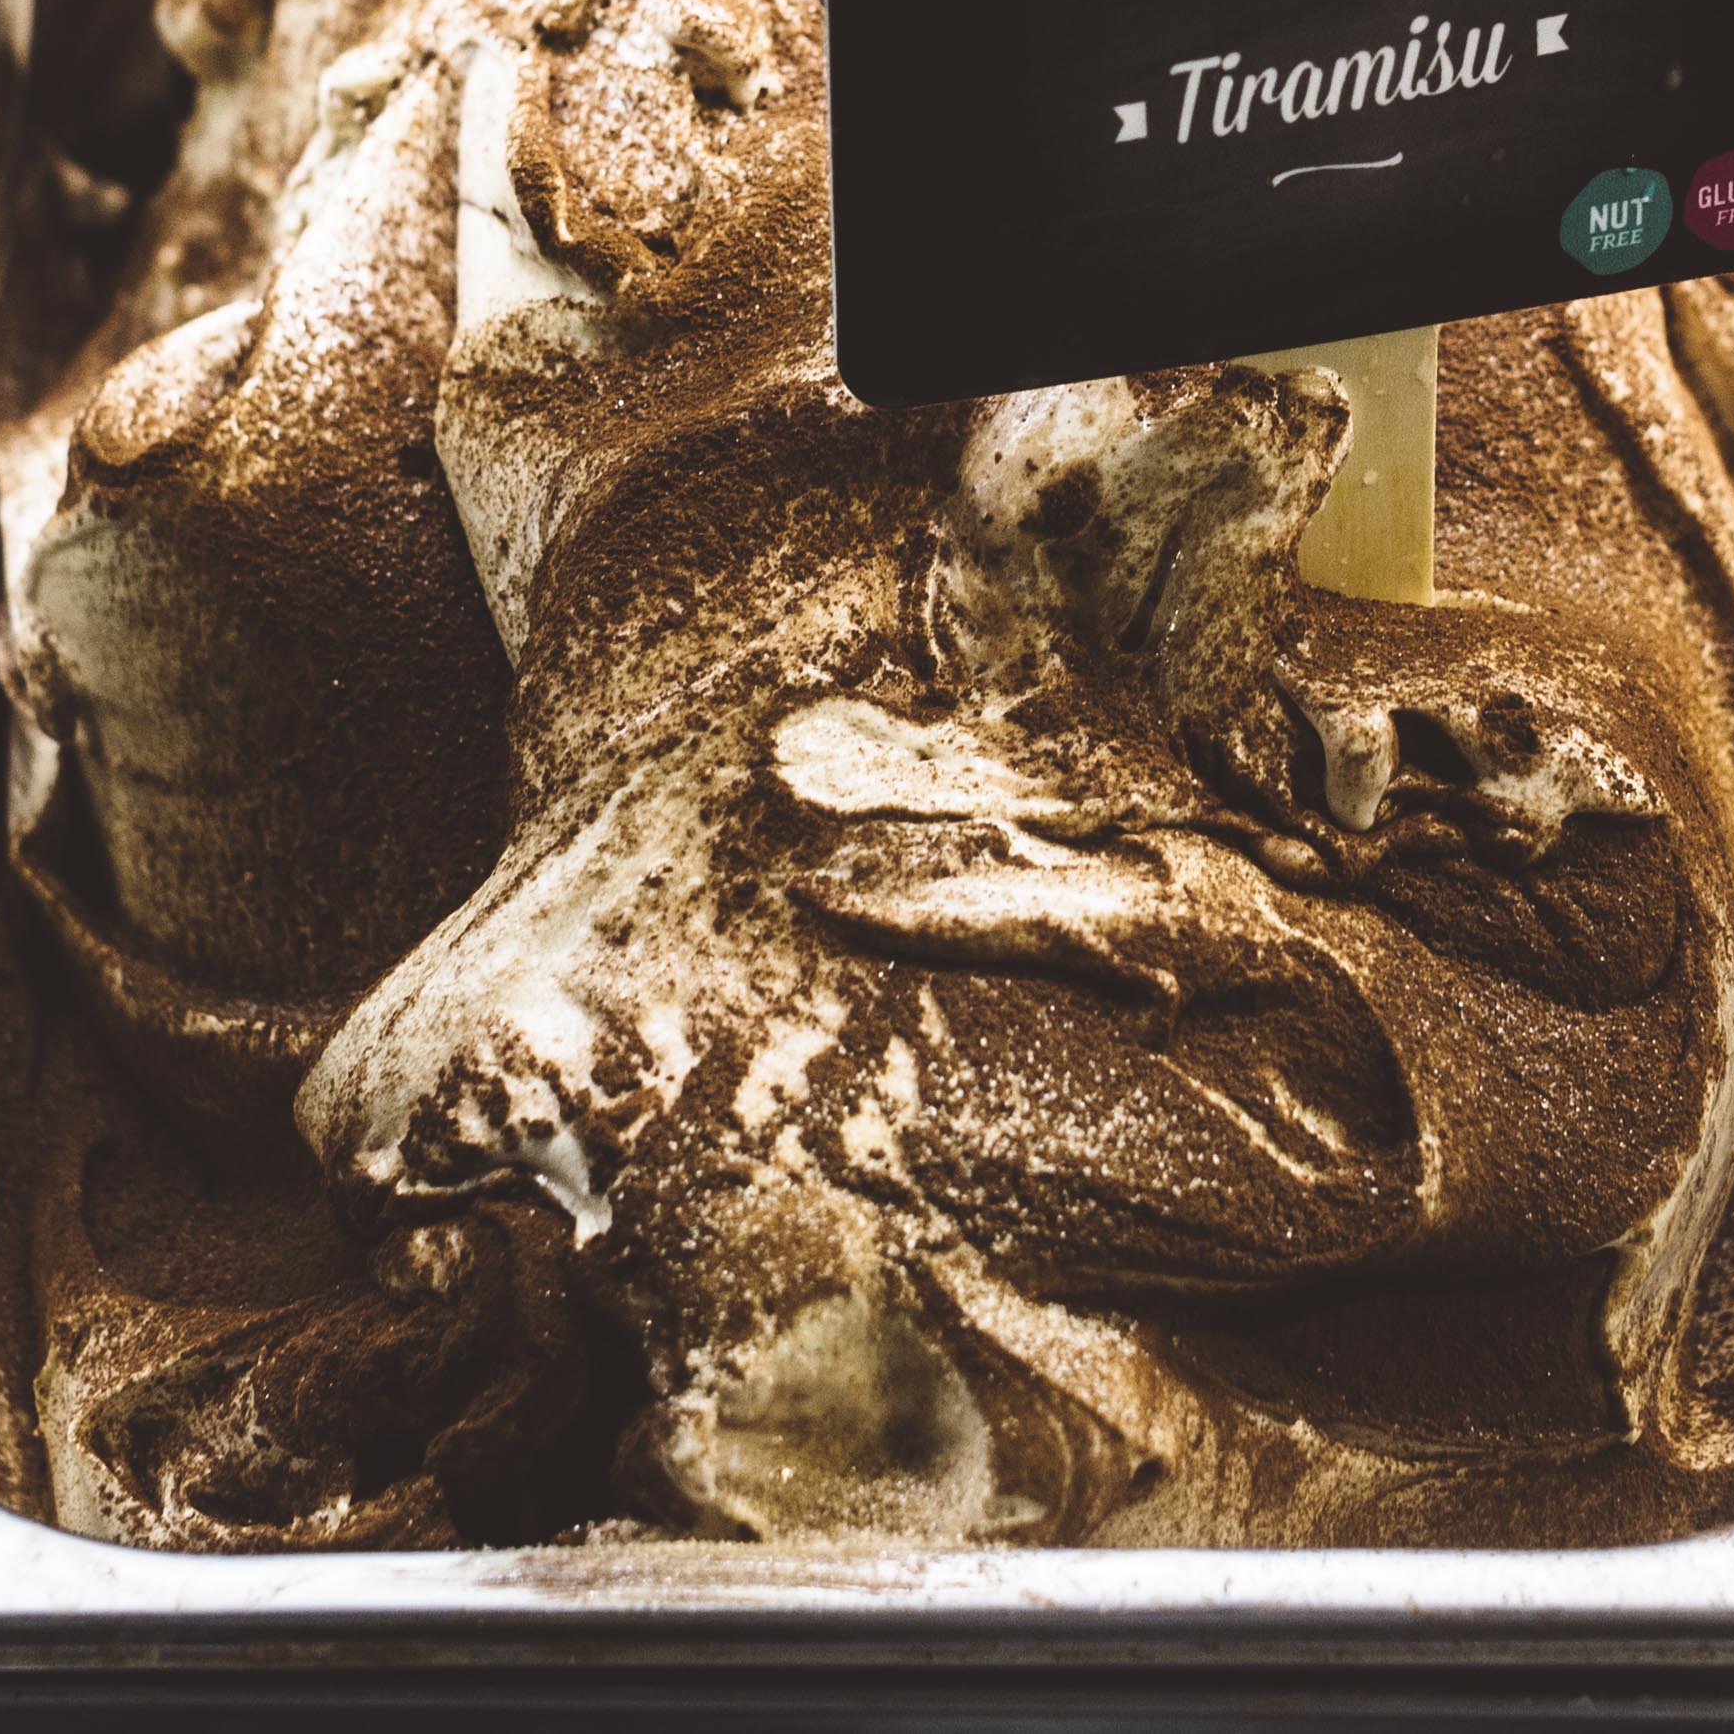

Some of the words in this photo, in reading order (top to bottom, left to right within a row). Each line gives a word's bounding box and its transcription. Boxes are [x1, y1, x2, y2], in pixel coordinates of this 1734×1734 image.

[1169, 15, 1513, 144] Tiramisu
[1589, 196, 1648, 234] NUT
[1589, 228, 1644, 252] FREE
